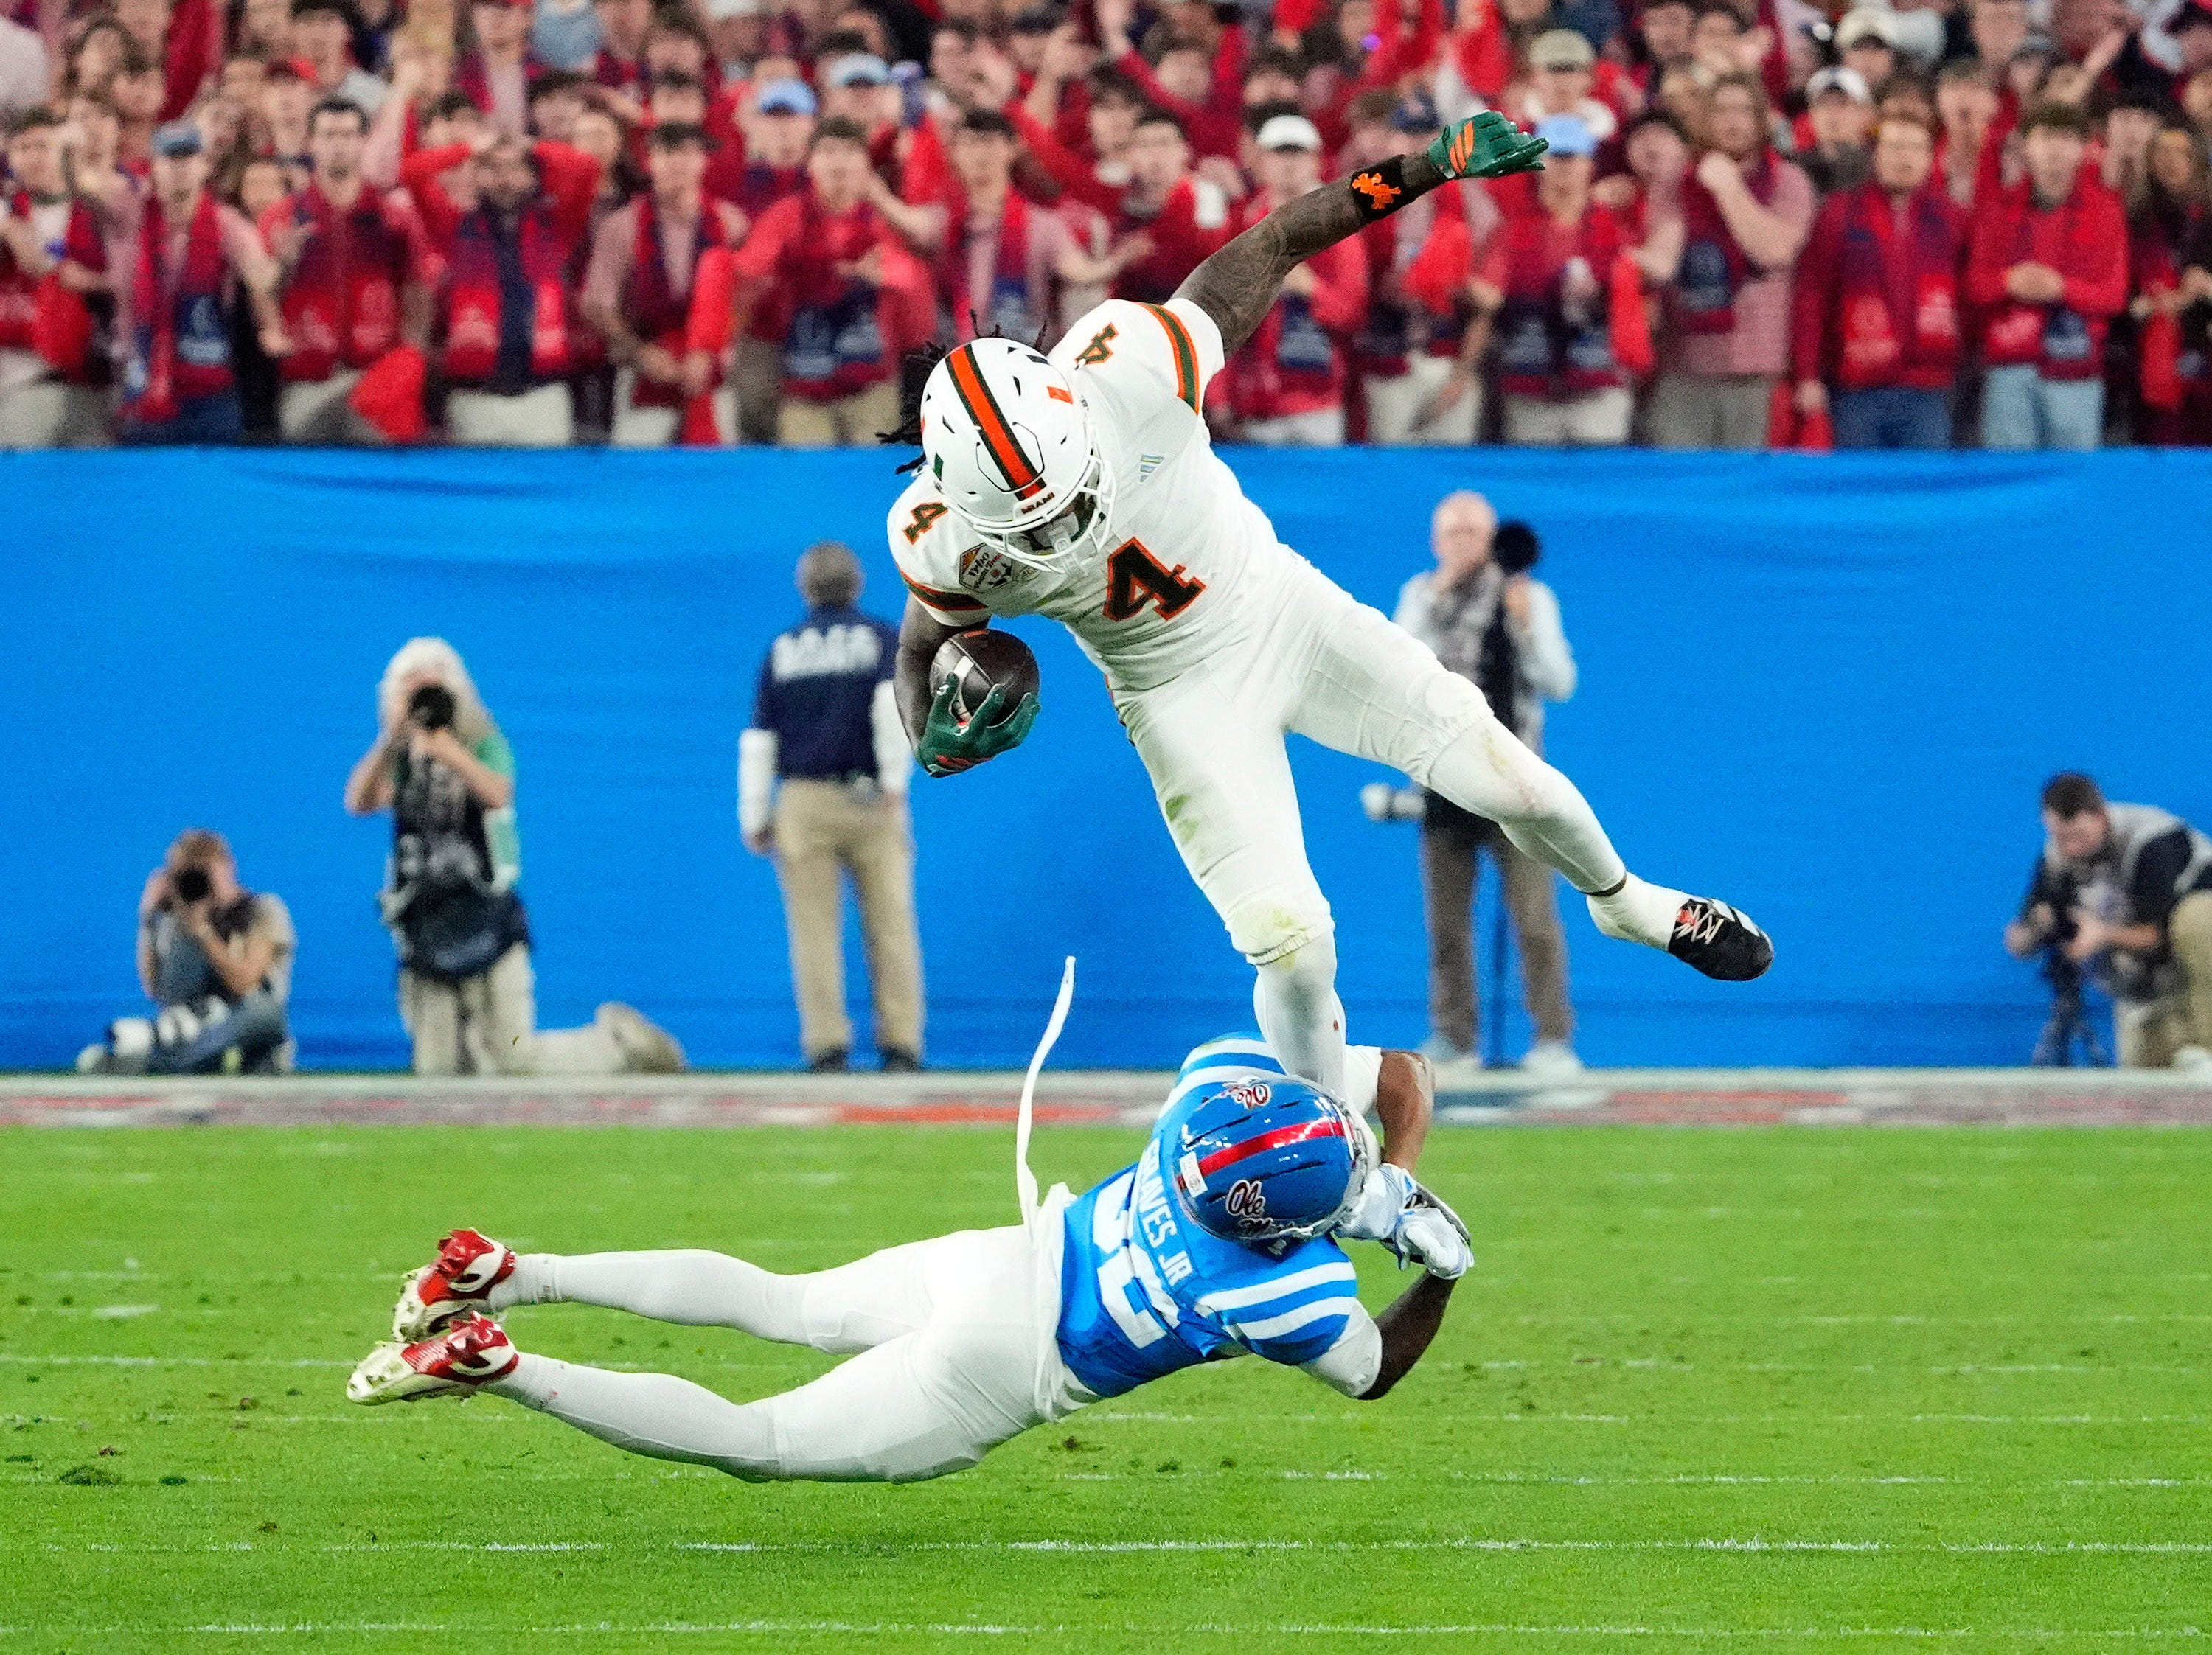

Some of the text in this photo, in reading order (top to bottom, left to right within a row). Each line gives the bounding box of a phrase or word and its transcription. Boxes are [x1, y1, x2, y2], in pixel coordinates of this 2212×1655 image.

[1074, 322, 1119, 365] 4
[903, 502, 948, 545] 4
[1104, 536, 1207, 622] 4
[1226, 1179, 1265, 1217] Ole
[1158, 1250, 1194, 1287] JR
